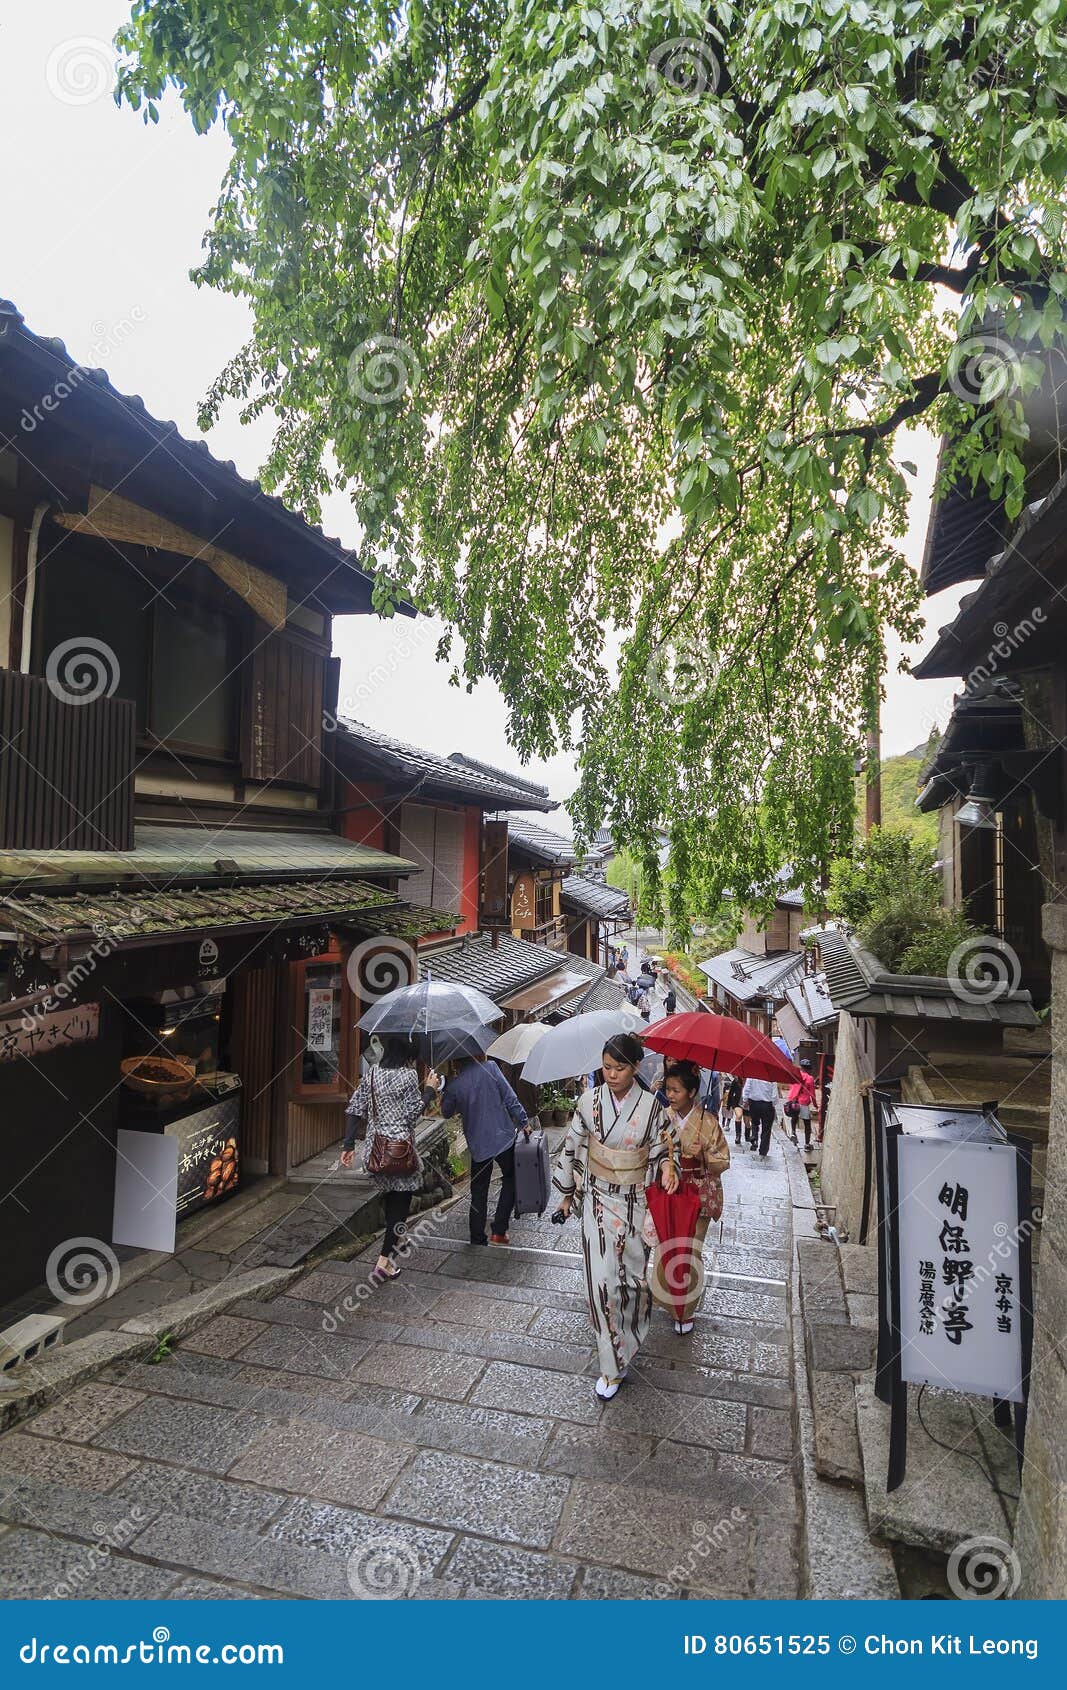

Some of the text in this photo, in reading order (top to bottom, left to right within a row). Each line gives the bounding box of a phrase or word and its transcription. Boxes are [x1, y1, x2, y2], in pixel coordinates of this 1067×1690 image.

[0, 1016, 91, 1058] 京やきぐり
[178, 1140, 225, 1173] 京やきぐり
[938, 1181, 975, 1345] 明保野亭
[994, 1273, 1014, 1333] 京弁当
